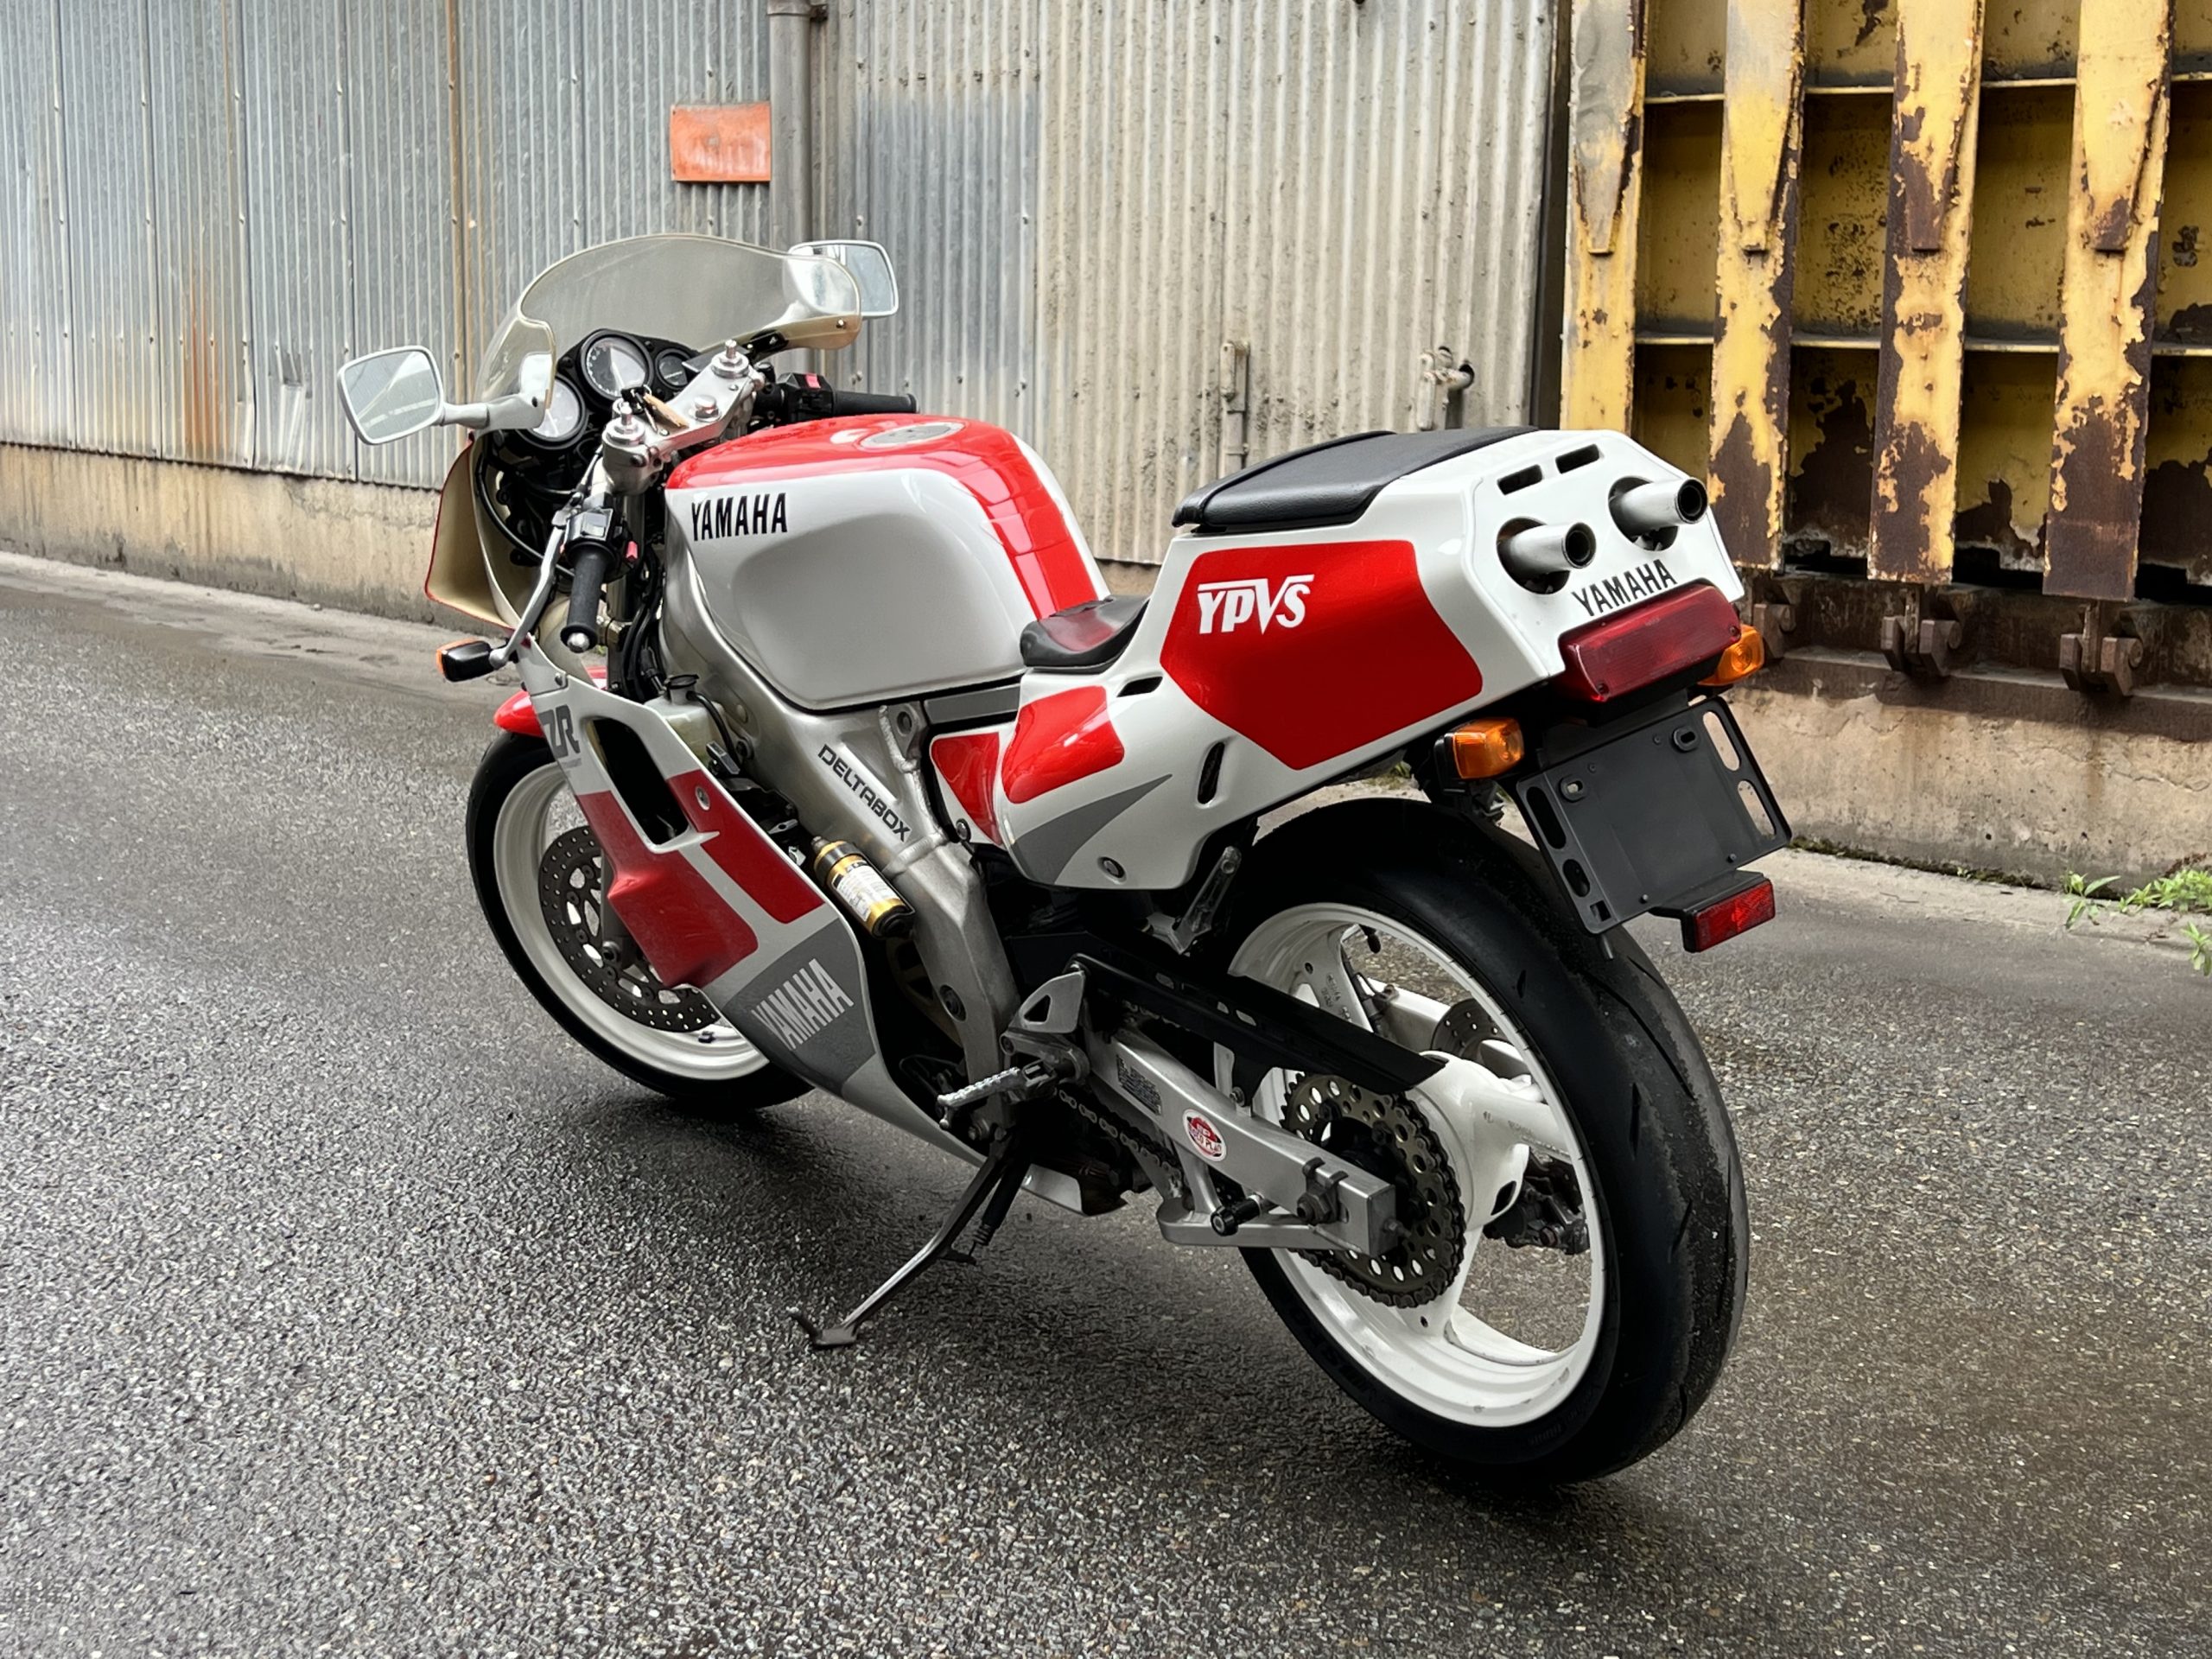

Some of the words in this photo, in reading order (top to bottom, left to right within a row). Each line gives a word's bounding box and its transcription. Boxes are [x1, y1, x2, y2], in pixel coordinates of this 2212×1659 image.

[691, 493, 787, 542] YAMAHA
[1197, 574, 1315, 635] YPVS
[1571, 558, 1678, 617] YAMAHA
[817, 744, 911, 842] DELTABOX
[750, 958, 855, 1051] YAMAHA
